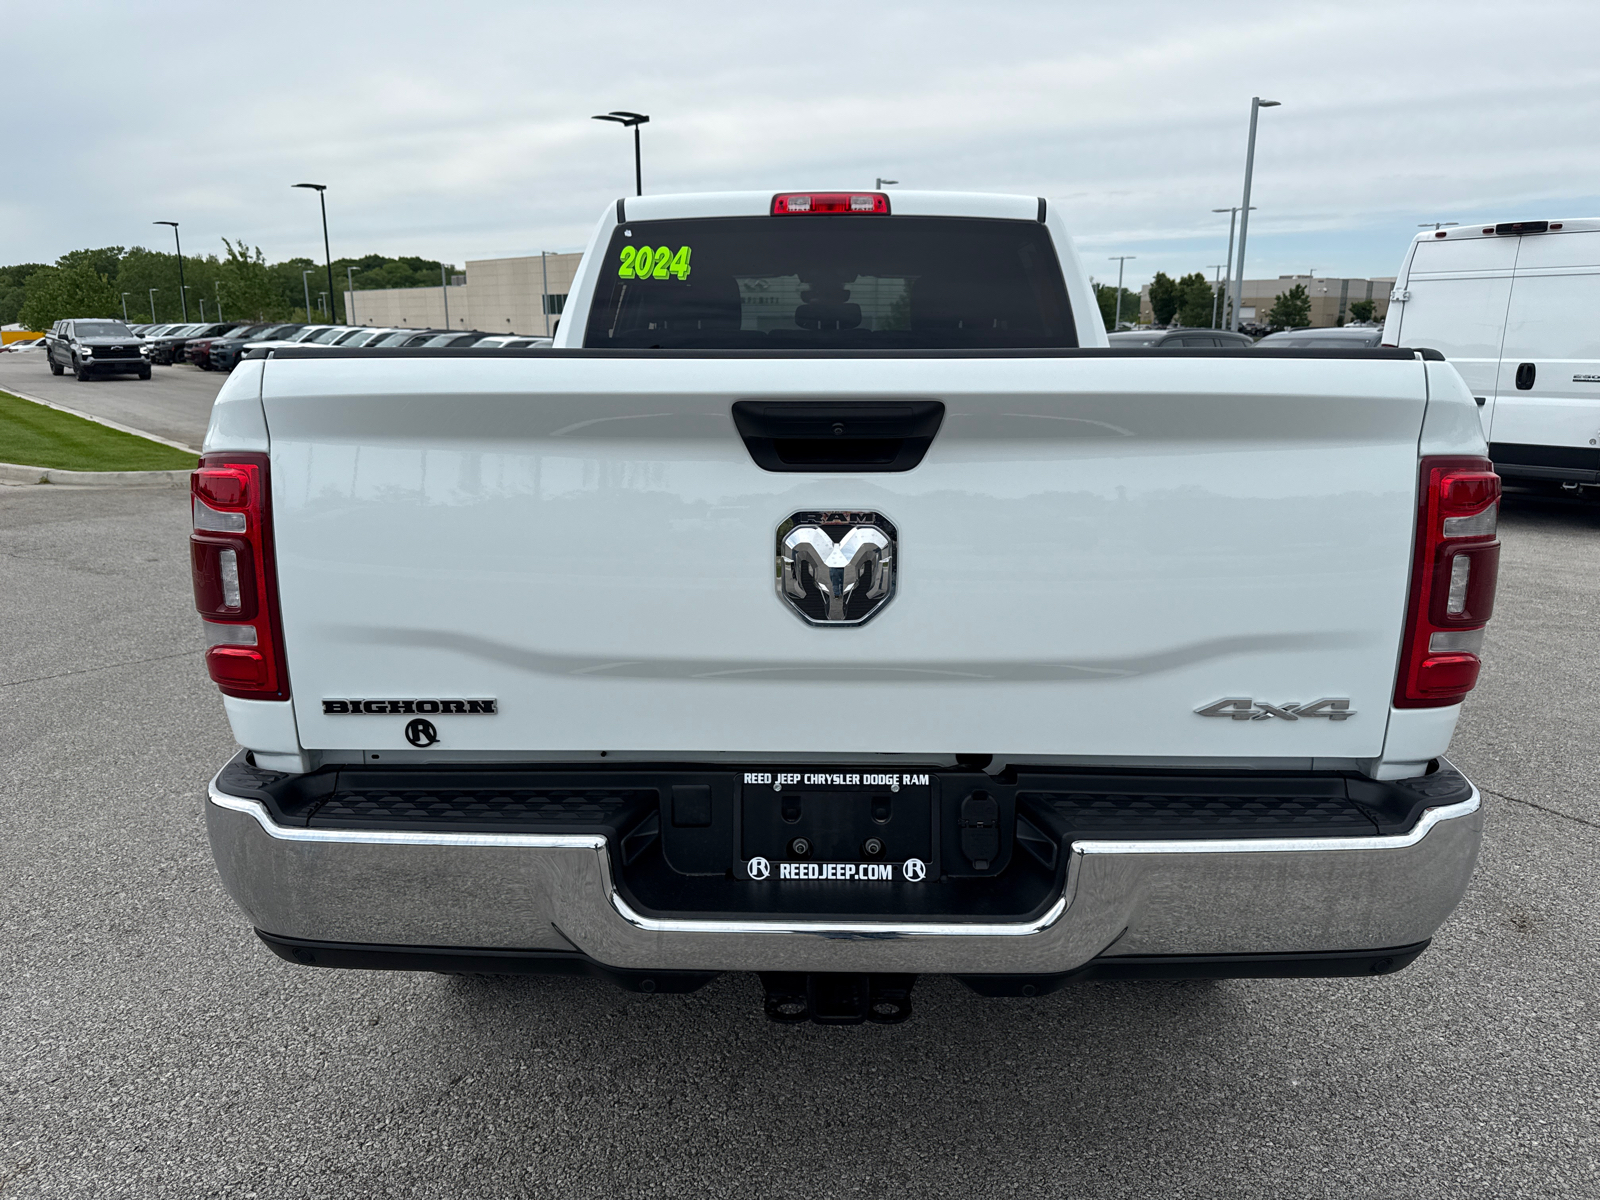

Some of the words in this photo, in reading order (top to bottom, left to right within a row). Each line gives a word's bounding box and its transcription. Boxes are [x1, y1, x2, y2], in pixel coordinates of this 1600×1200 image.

[618, 245, 692, 280] 2024
[800, 511, 876, 524] RAM
[322, 698, 498, 715] BIGHORN
[407, 719, 440, 746] R
[743, 773, 772, 784] REED
[774, 773, 801, 785] JEEP
[804, 773, 861, 786] CHRYSLER
[863, 774, 900, 786] DODGE
[902, 774, 930, 786] RAM
[749, 858, 771, 880] R
[779, 863, 893, 881] REEDJEEP.COM
[904, 859, 926, 881] R
